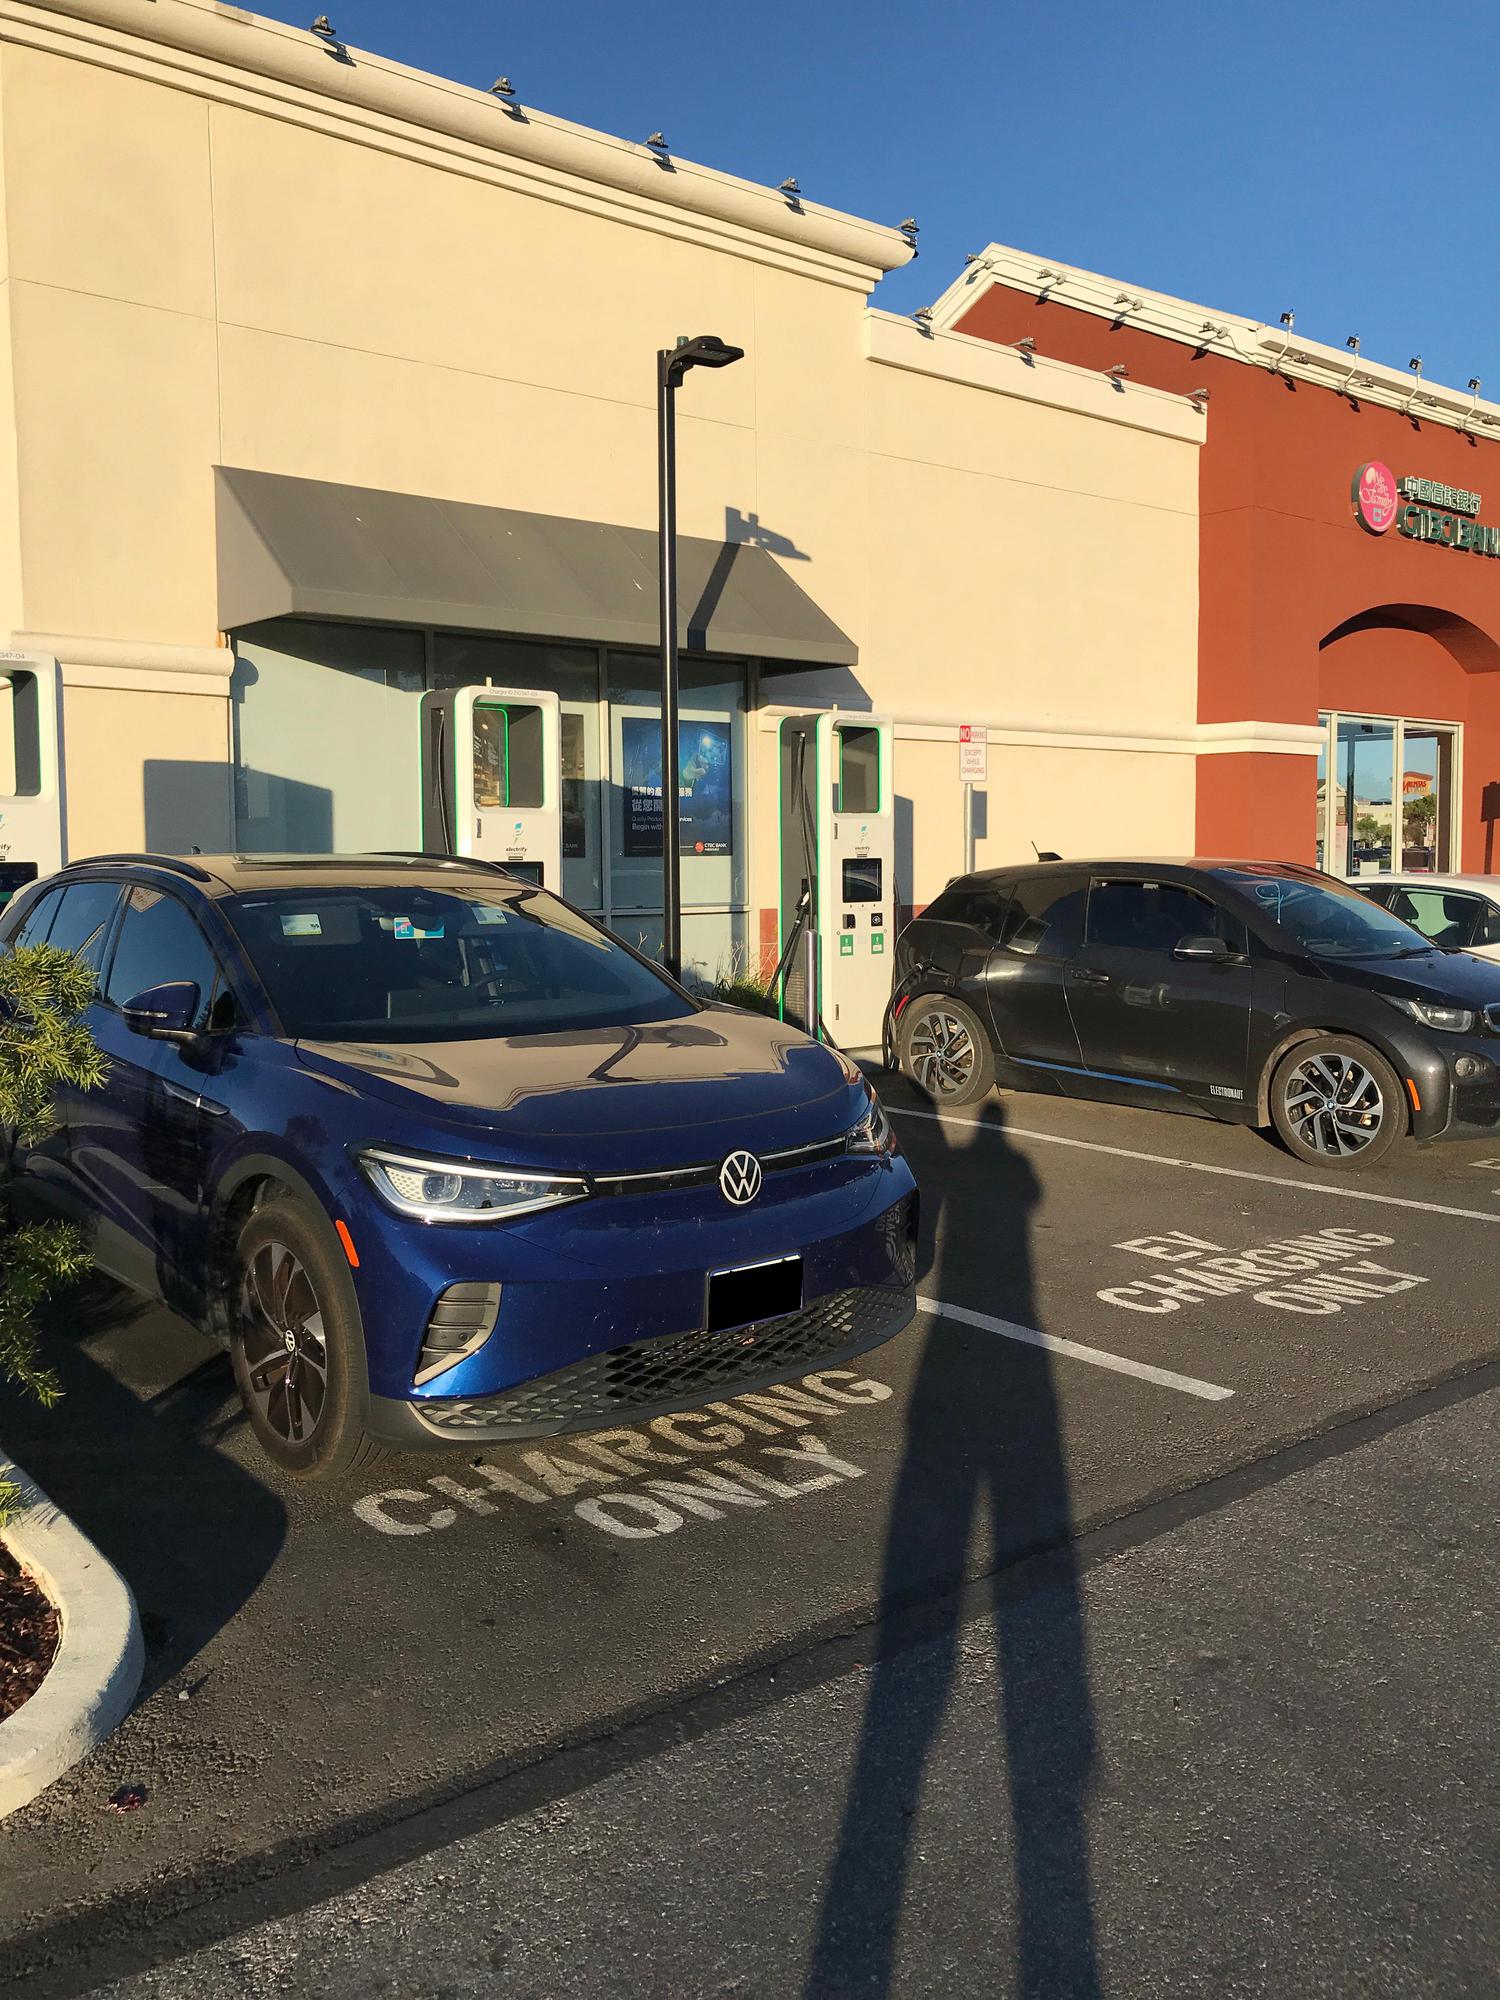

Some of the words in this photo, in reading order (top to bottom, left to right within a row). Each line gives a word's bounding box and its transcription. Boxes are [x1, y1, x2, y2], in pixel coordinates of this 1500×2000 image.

[1404, 476, 1482, 514] 中國信託銀行
[1457, 517, 1500, 555] BAN
[960, 727, 970, 740] NO
[632, 823, 650, 831] Begin
[1209, 1085, 1243, 1099] ELECTRONAUT
[720, 1150, 762, 1205] VW
[1112, 1230, 1228, 1262] EV
[1096, 1228, 1396, 1314] CHARGING
[1253, 1260, 1431, 1315] ONLY
[352, 1370, 893, 1536] CHARGING
[573, 1434, 866, 1538] ONLY
